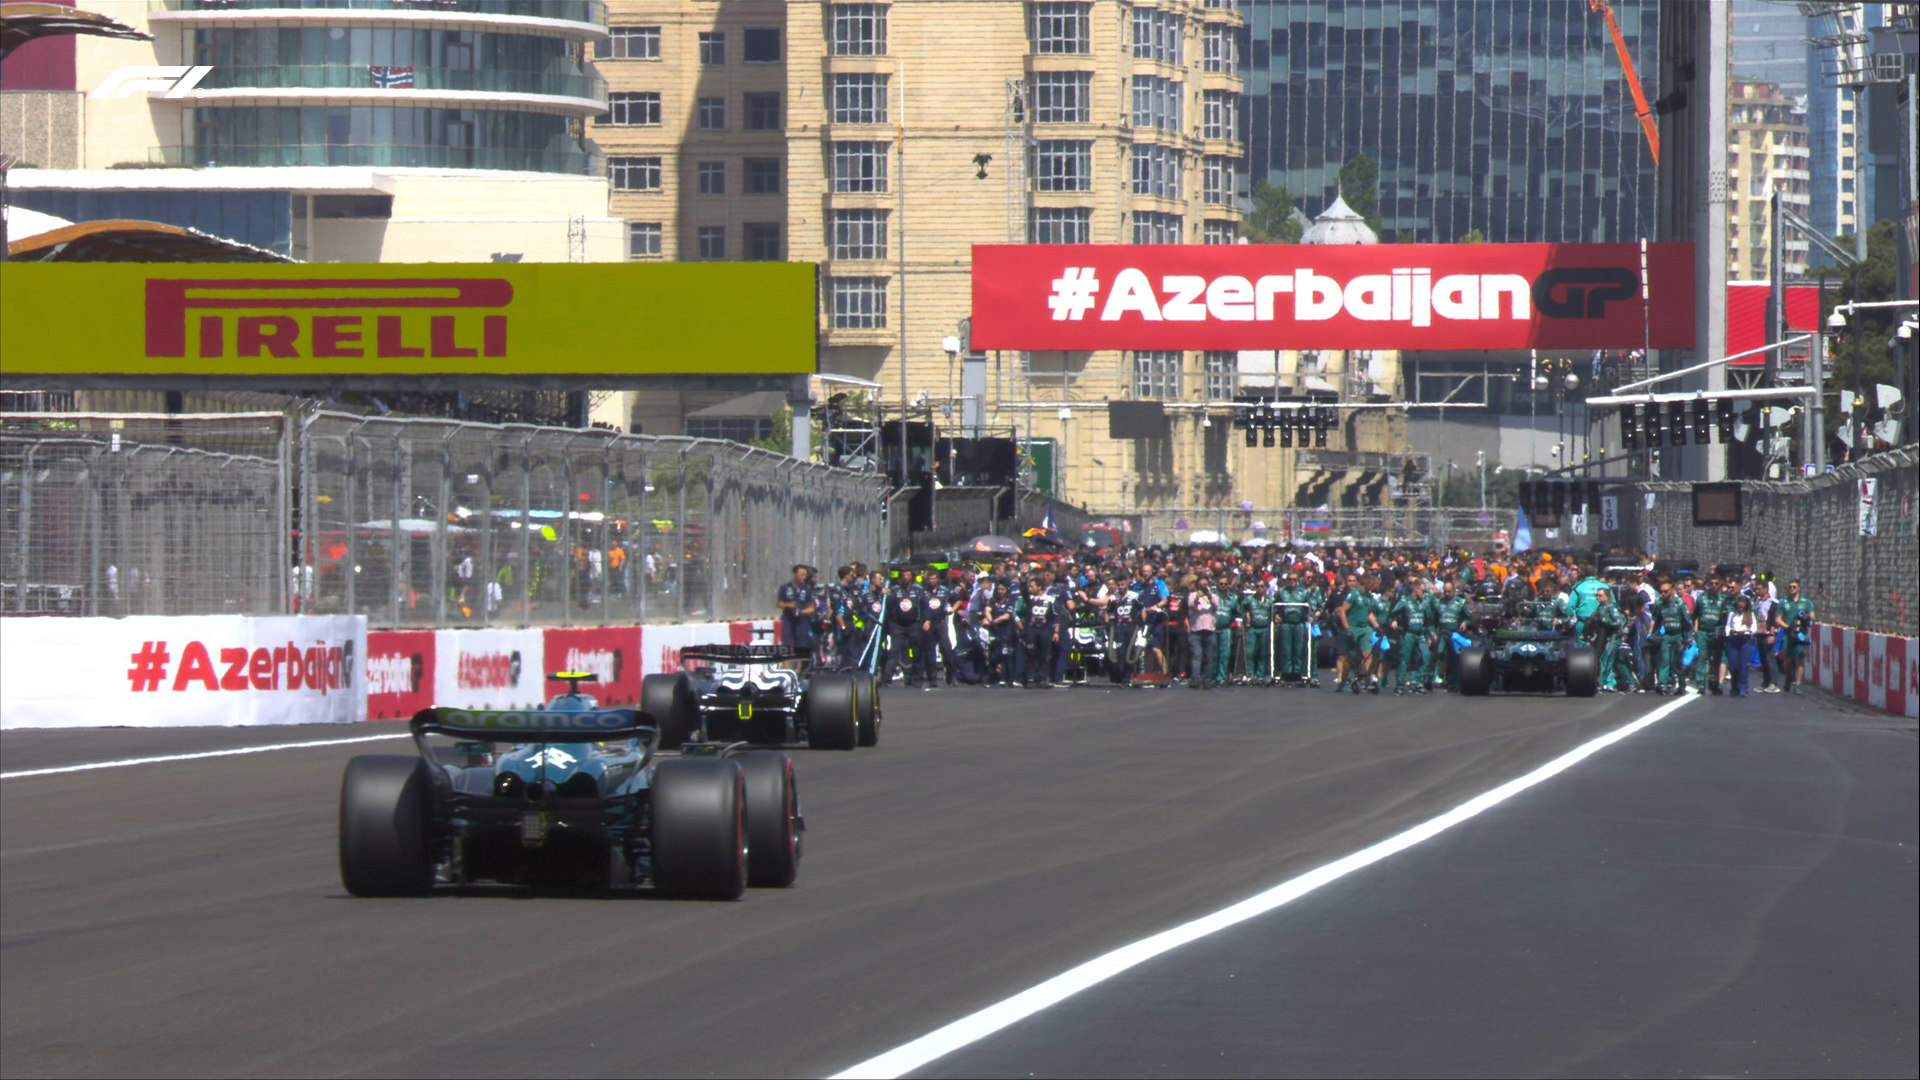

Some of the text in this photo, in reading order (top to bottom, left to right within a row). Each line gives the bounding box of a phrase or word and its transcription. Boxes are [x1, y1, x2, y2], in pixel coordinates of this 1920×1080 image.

[145, 278, 514, 357] PIRELLI
[1605, 499, 1614, 529] 150
[446, 711, 627, 728] aramco
